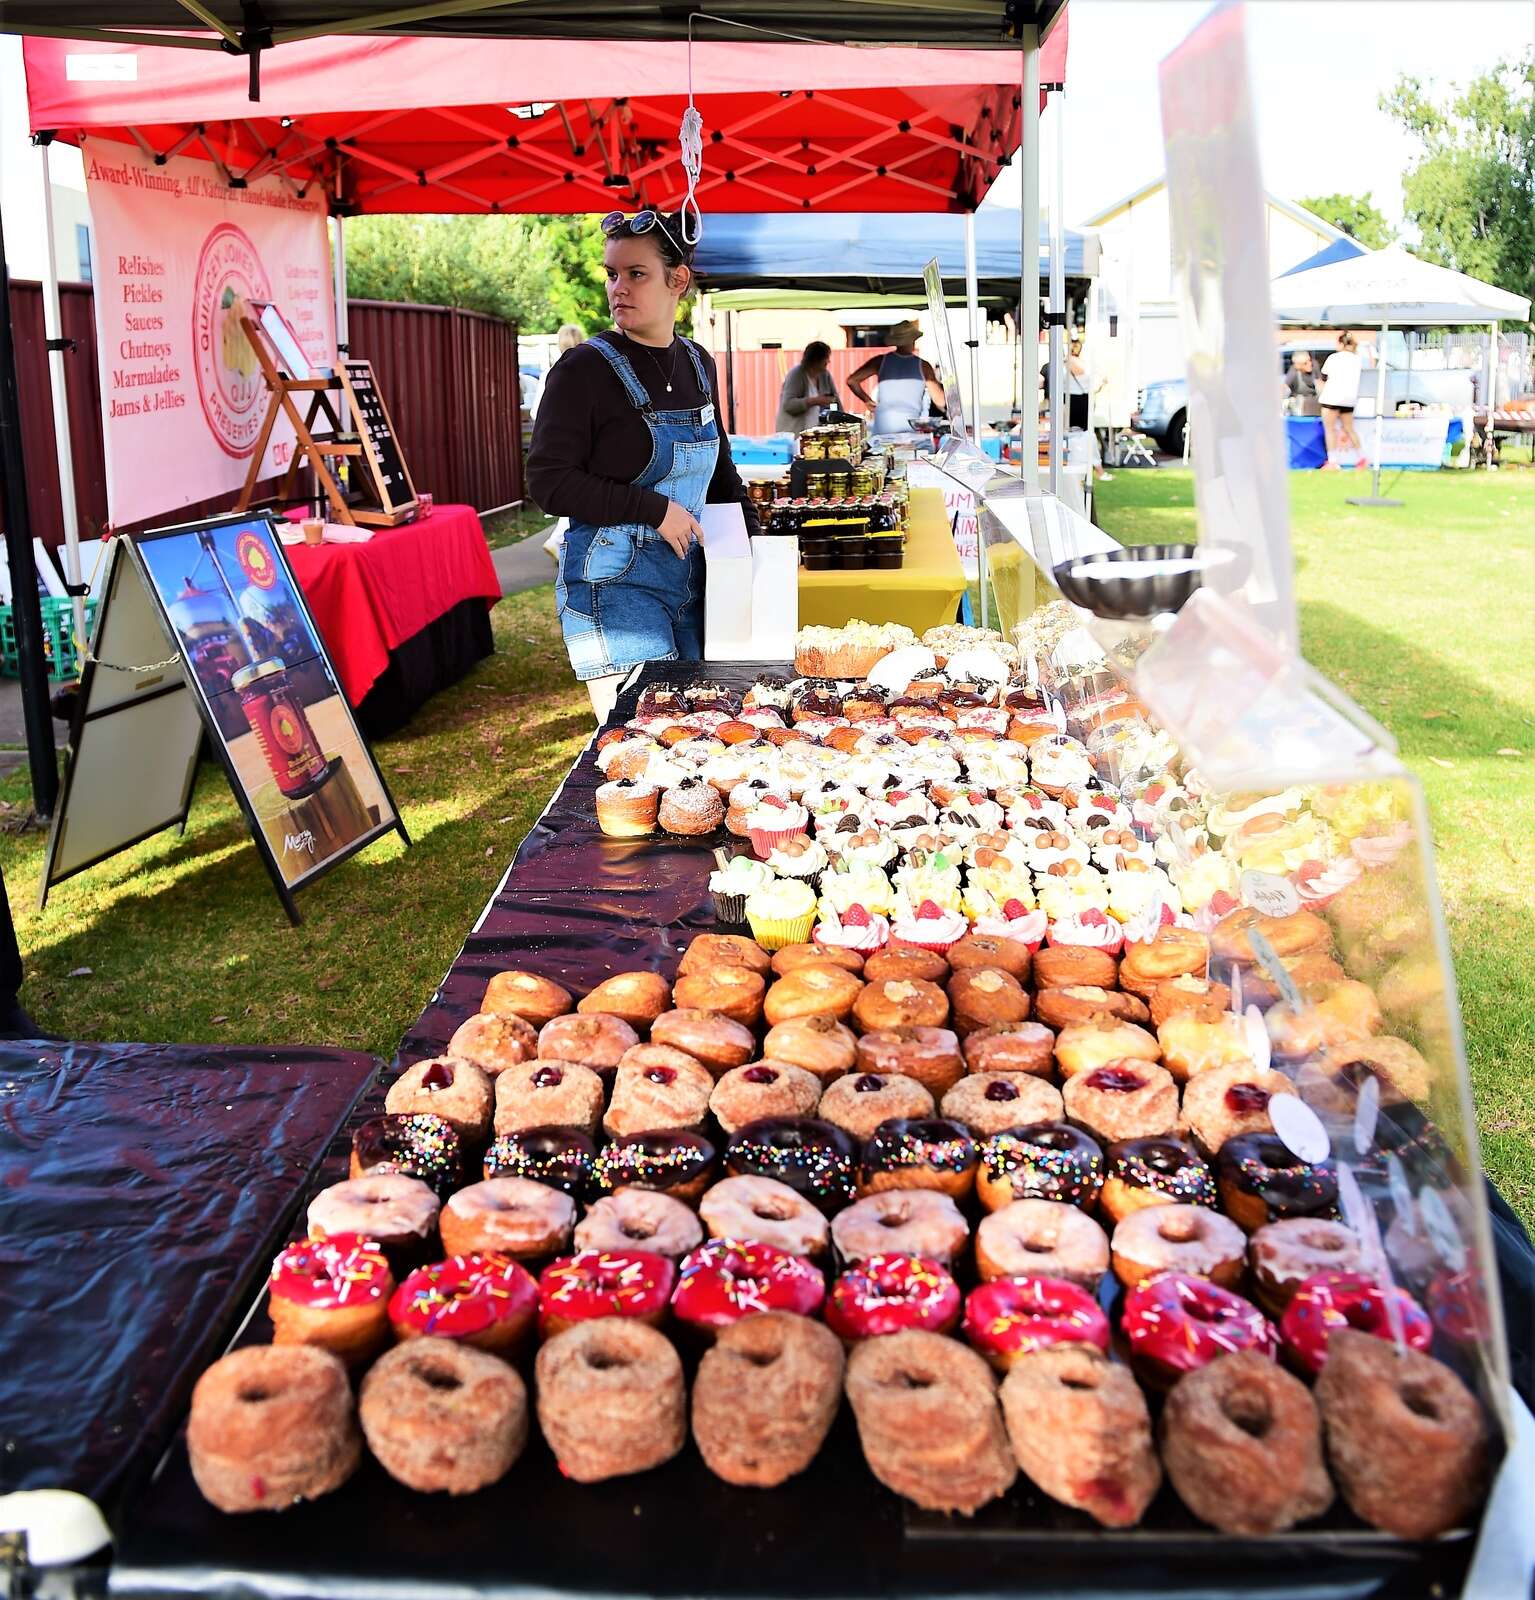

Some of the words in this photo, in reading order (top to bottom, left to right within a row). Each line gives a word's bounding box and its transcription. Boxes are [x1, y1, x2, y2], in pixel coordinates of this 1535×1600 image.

[118, 255, 165, 275] Relishes
[123, 283, 163, 303] Pickles
[125, 312, 164, 331] Sauces
[120, 339, 172, 361] Chutneys
[113, 363, 181, 389] Marmalades
[109, 399, 141, 418] Jams
[142, 394, 152, 413] &
[153, 389, 186, 411] Jellies
